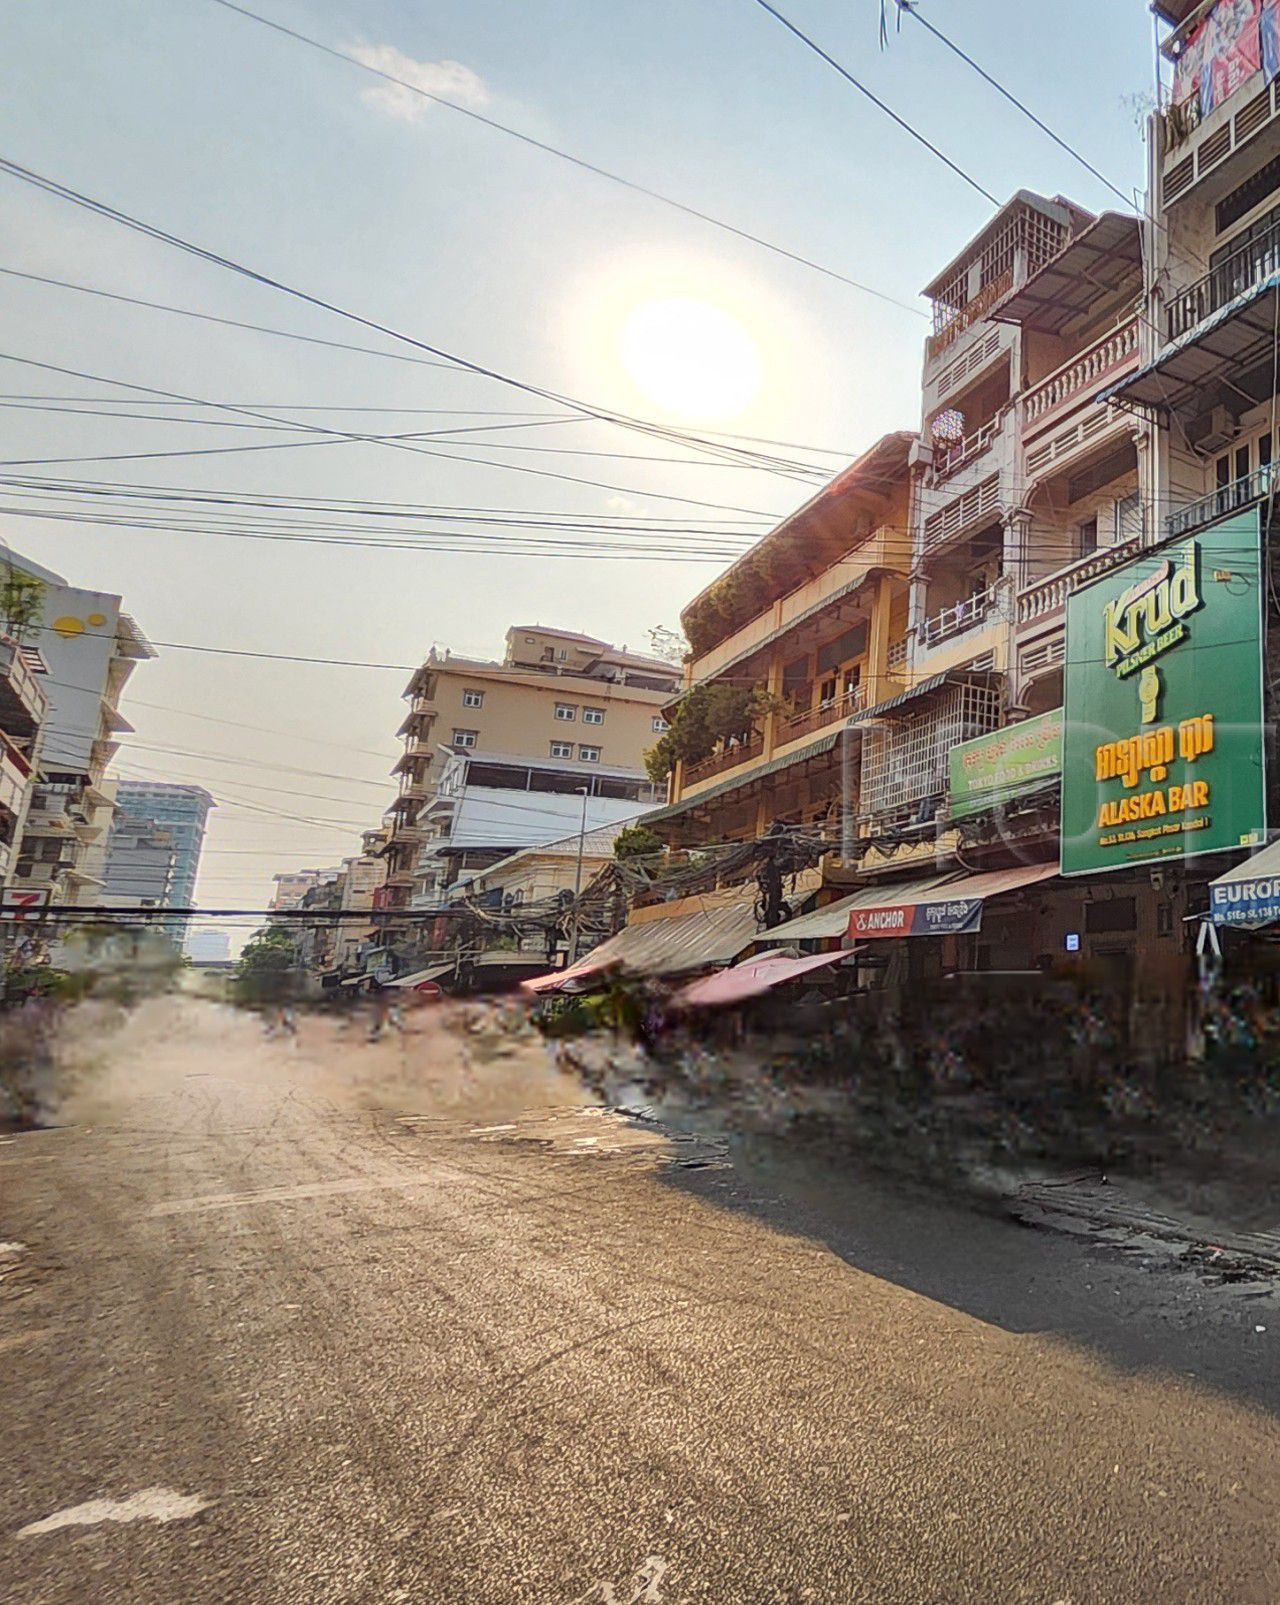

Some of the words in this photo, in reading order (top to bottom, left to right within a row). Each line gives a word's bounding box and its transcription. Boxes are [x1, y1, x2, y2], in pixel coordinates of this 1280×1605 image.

[1103, 537, 1199, 667] Krud
[1116, 641, 1156, 679] PILSNER
[1157, 623, 1184, 651] BEER
[1098, 790, 1165, 828] ALASKA
[1168, 780, 1209, 810] BAR
[867, 910, 905, 929] ANCHOR
